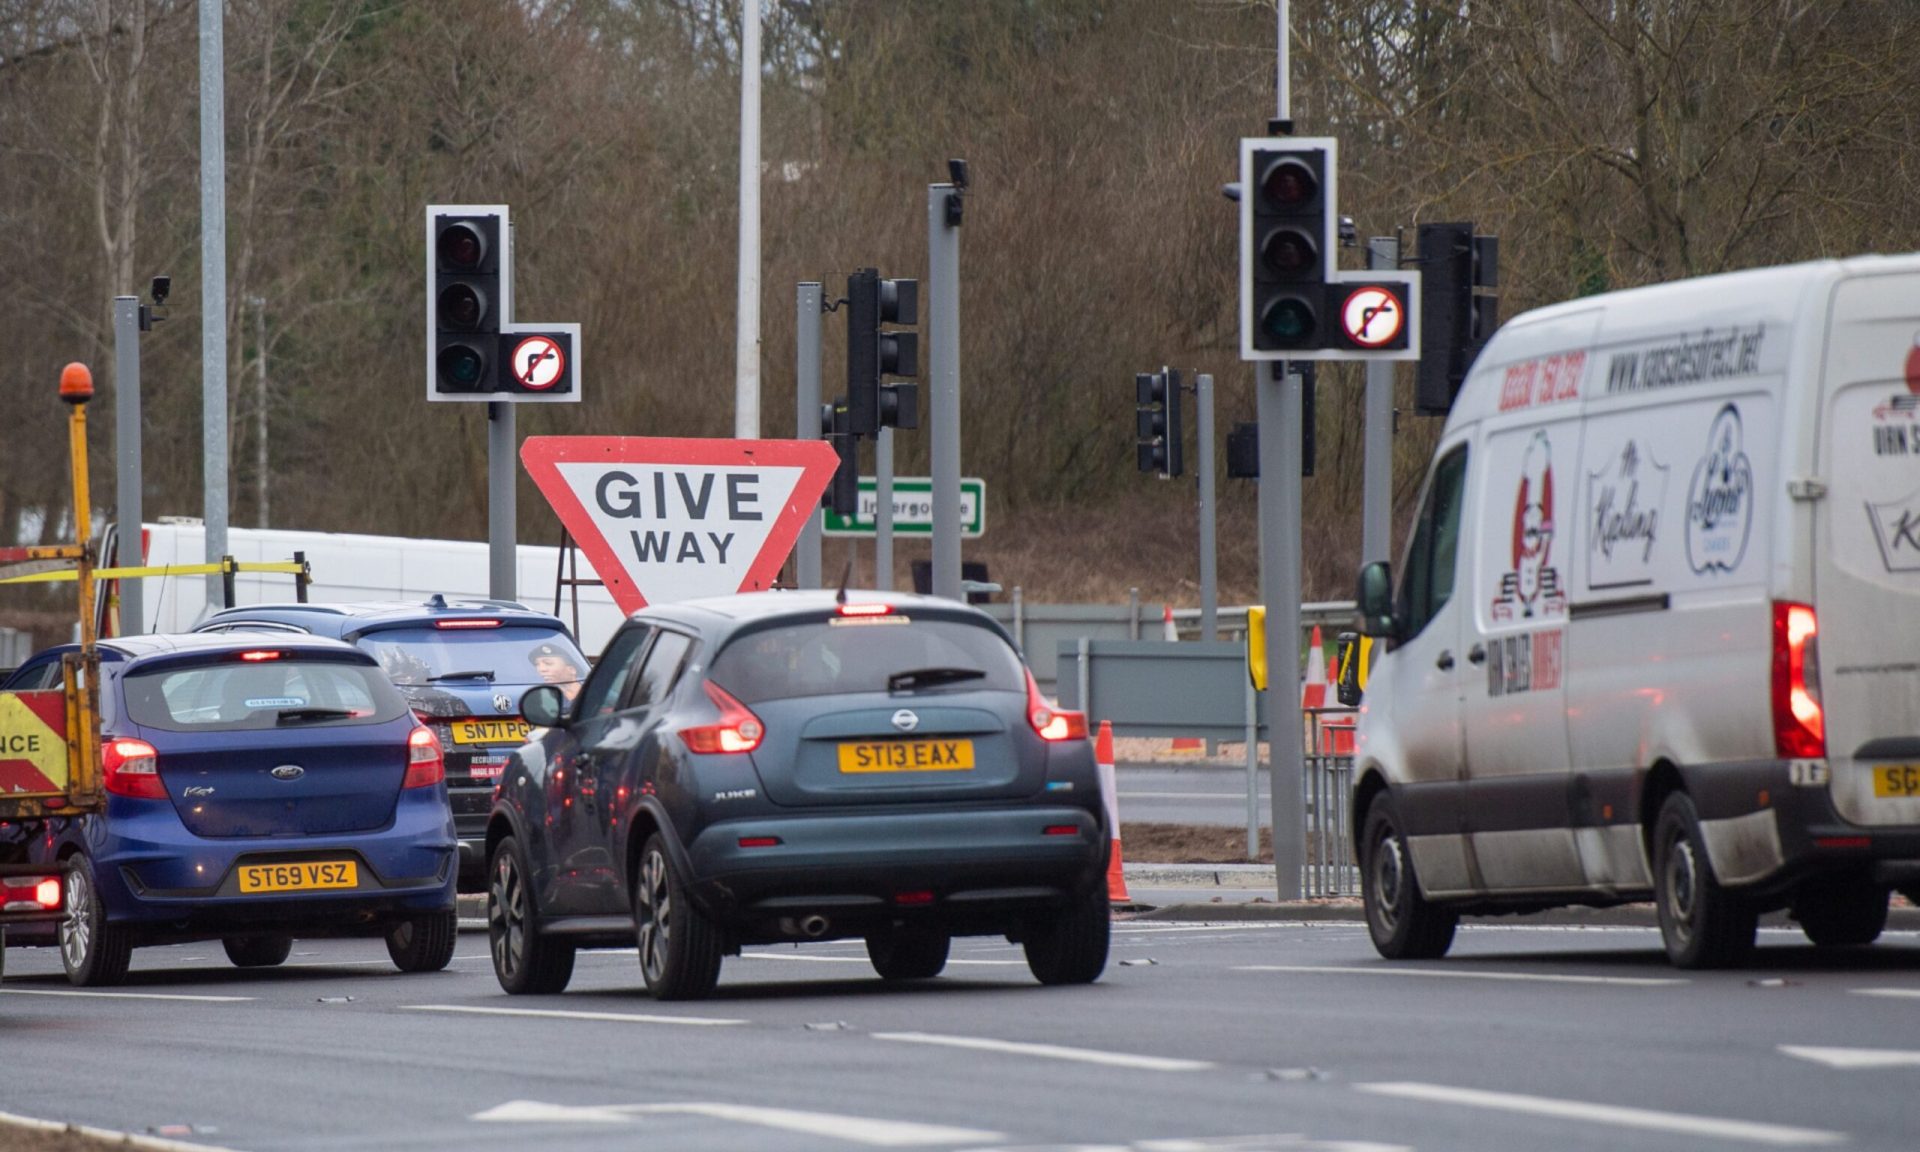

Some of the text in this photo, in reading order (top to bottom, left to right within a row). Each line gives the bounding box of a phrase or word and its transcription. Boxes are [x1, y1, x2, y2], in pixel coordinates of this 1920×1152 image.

[595, 470, 763, 521] GIVE
[863, 500, 969, 516] Inergoe
[630, 530, 735, 564] WAY
[464, 722, 535, 739] SN71 PG
[855, 743, 959, 767] ST13 EAX
[248, 863, 348, 887] ST69 VSZ
